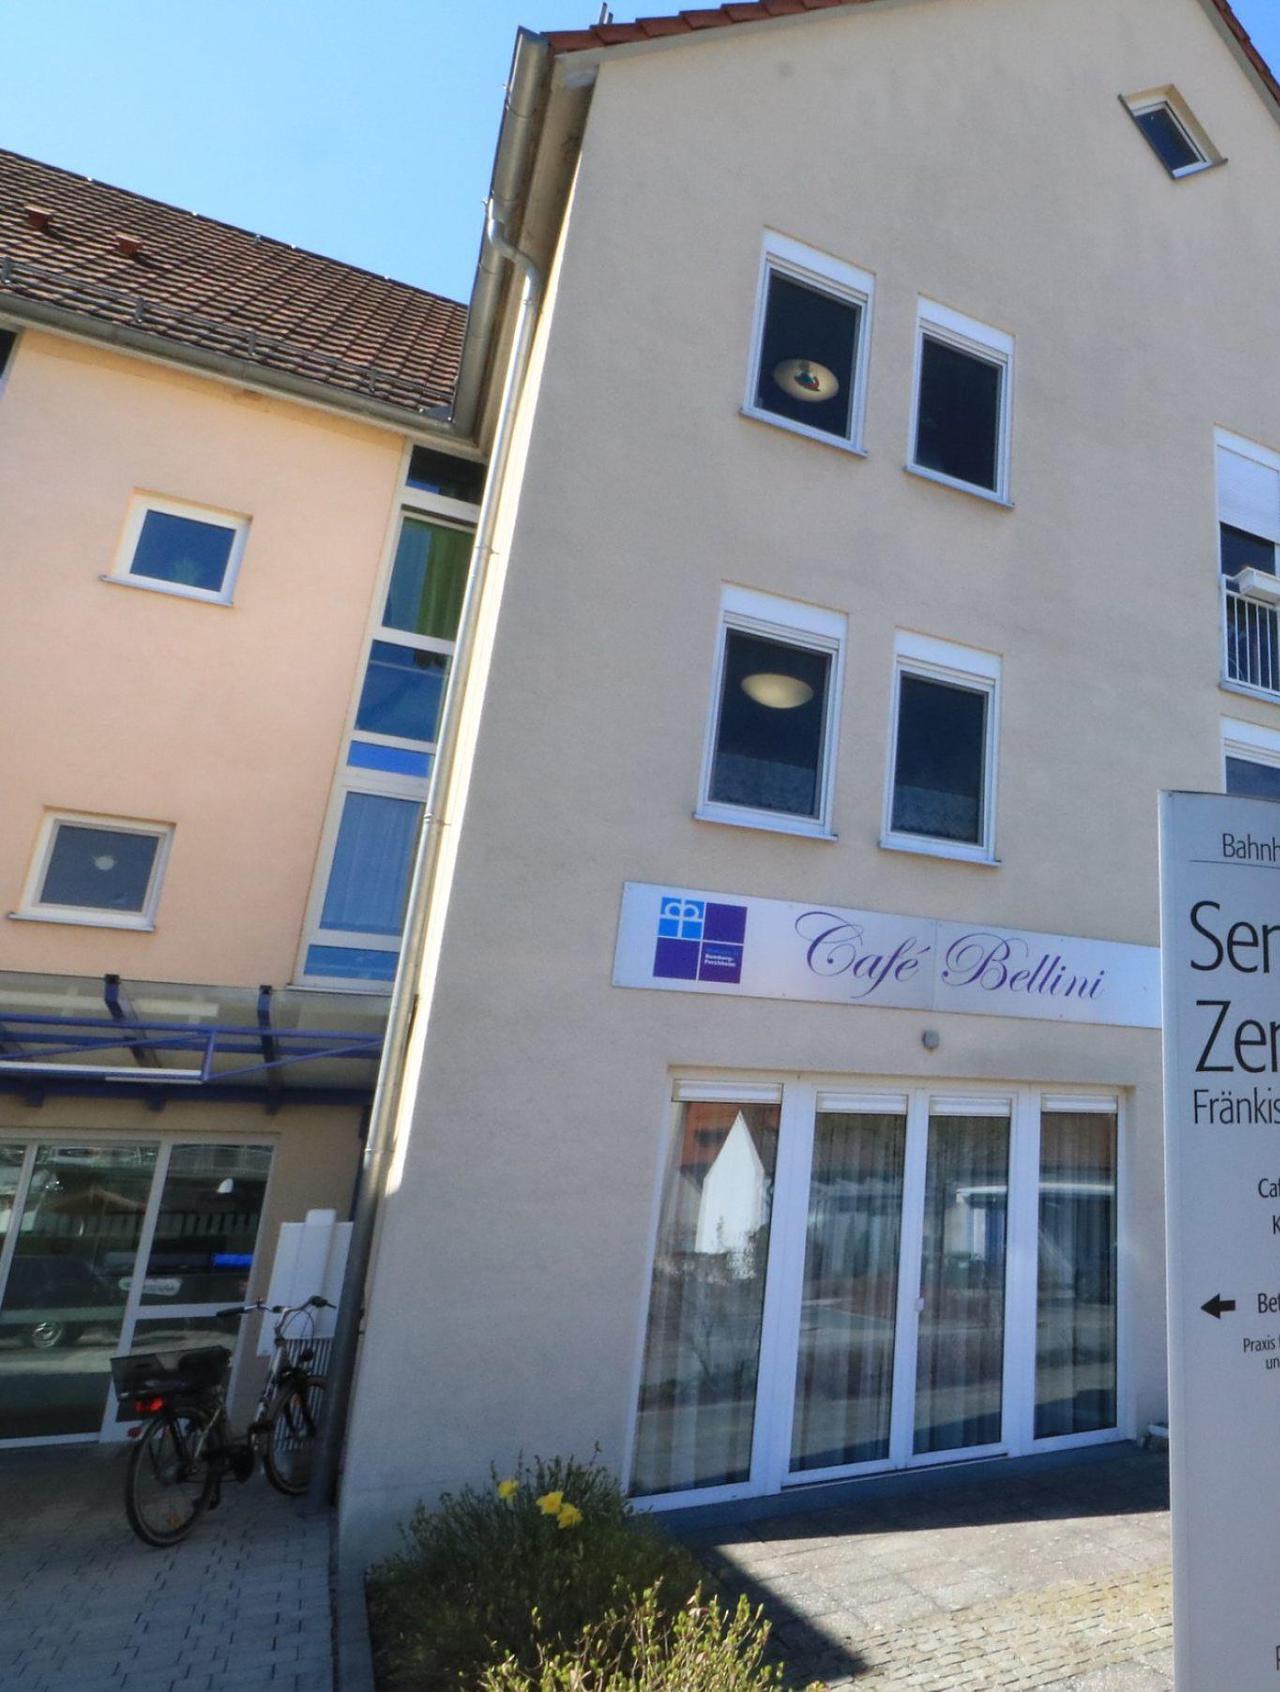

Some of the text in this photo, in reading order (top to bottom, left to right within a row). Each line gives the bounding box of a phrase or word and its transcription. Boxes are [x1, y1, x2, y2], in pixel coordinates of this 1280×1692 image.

[794, 911, 1106, 1001] Café Bellini
[1243, 1335, 1275, 1353] Praxis
